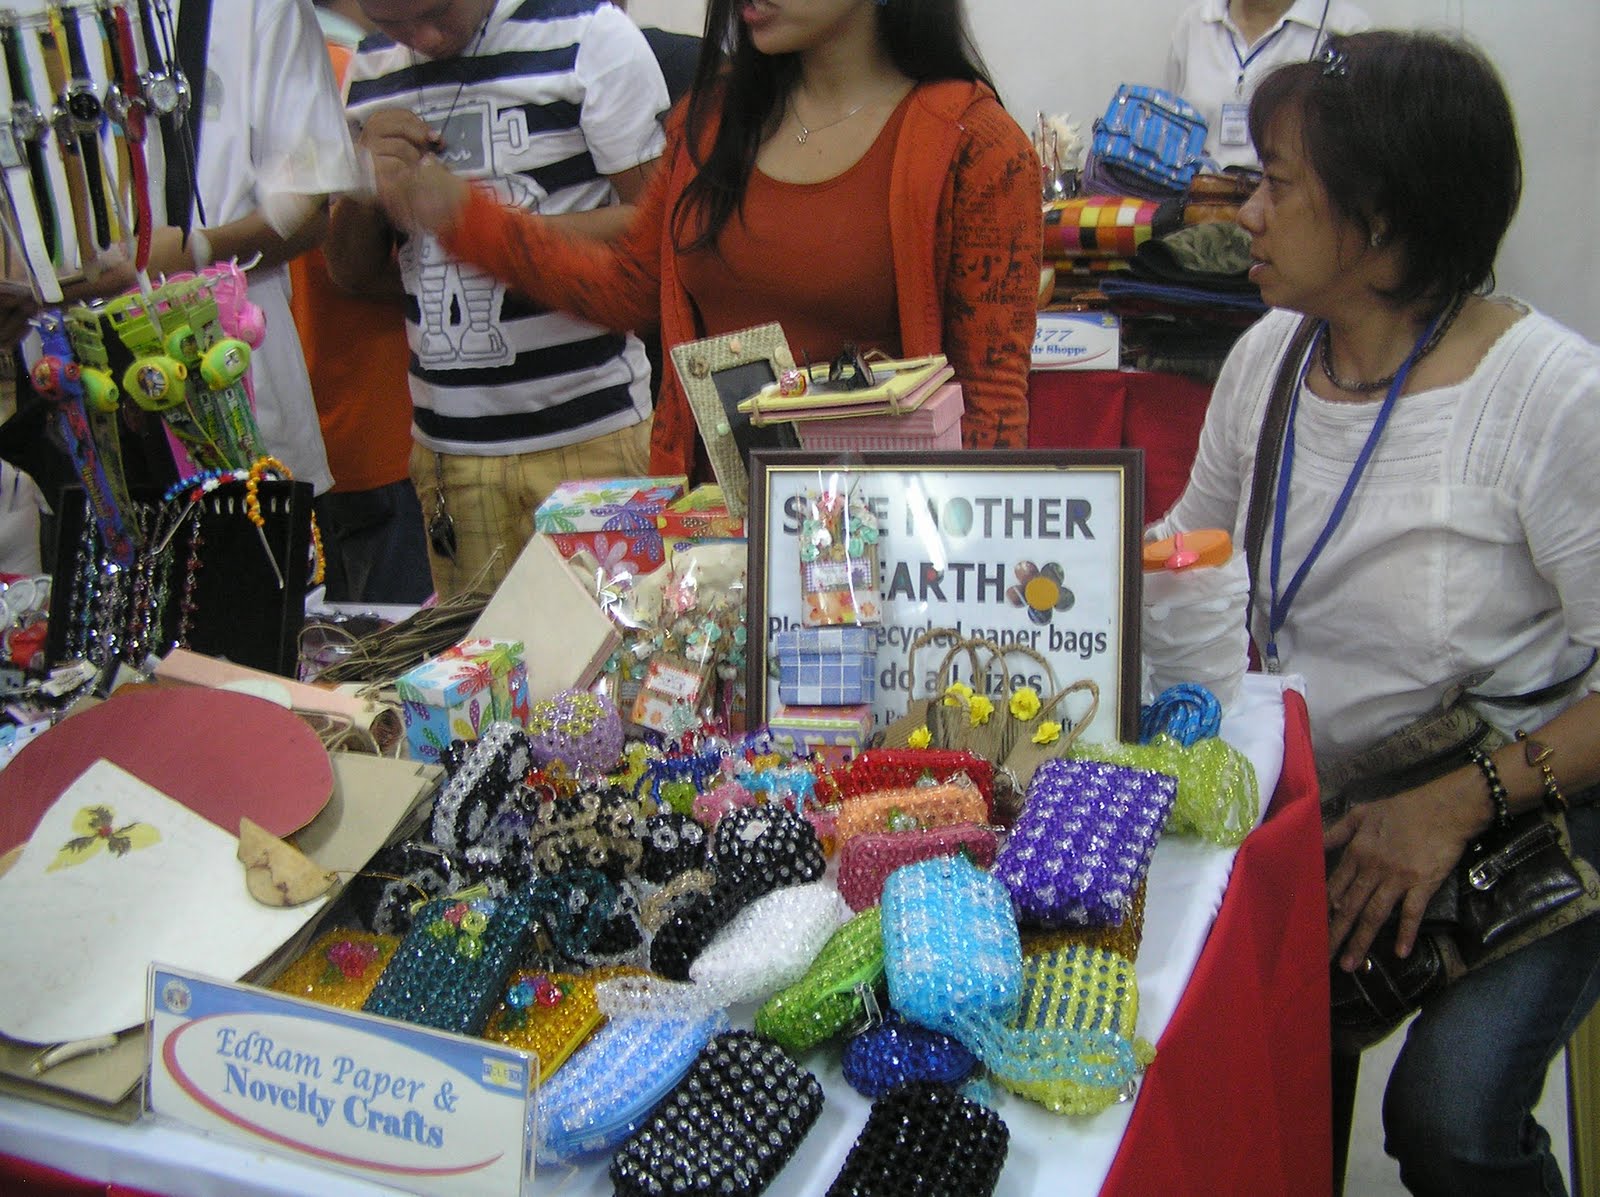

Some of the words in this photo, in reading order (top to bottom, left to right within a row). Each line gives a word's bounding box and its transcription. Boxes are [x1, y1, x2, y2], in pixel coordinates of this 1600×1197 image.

[783, 496, 889, 535] SE
[880, 561, 1006, 604] ARTH
[876, 619, 962, 653] ecycled
[1049, 623, 1108, 660] bags
[880, 661, 914, 691] do
[216, 1026, 322, 1079] EdRam
[332, 1056, 426, 1104] Paper
[433, 1081, 460, 1113] &
[222, 1062, 337, 1128] Novelty
[343, 1094, 444, 1149] Crafts
